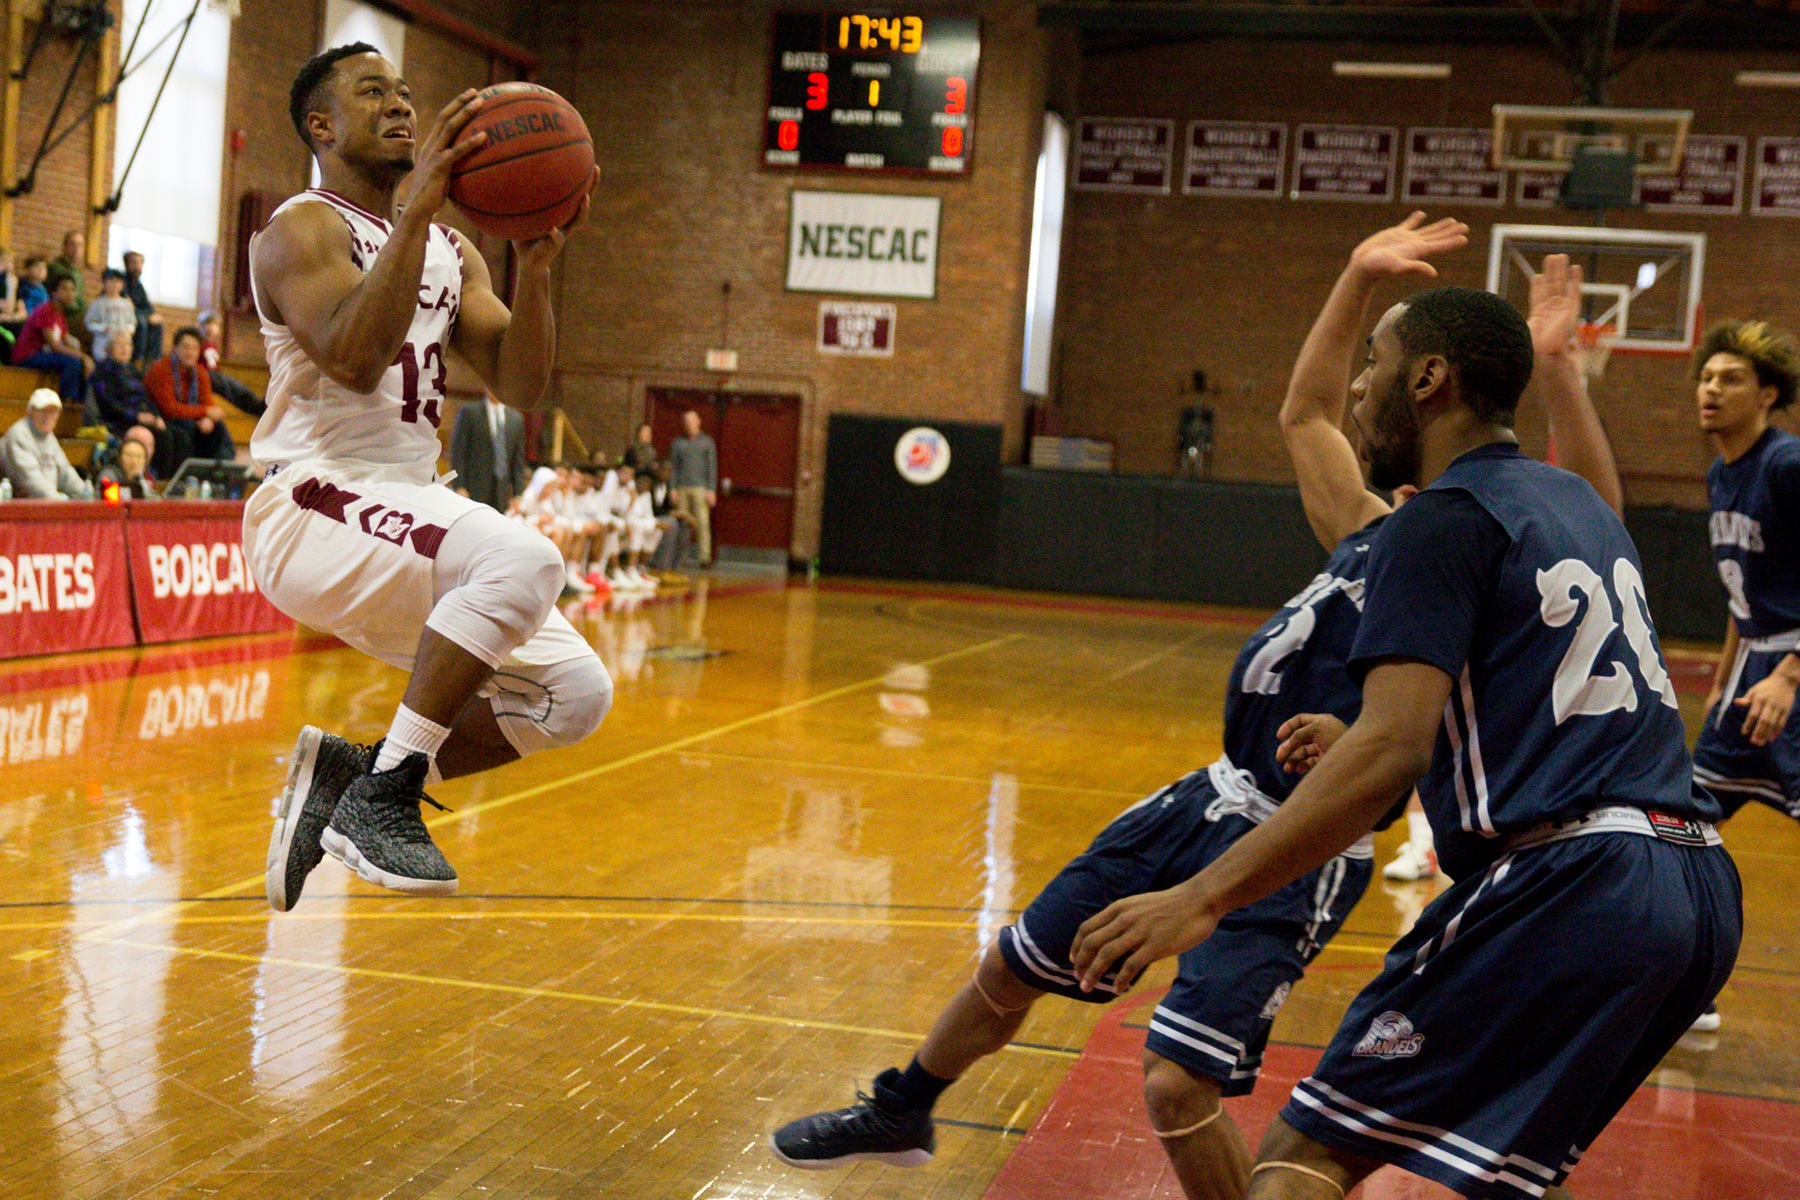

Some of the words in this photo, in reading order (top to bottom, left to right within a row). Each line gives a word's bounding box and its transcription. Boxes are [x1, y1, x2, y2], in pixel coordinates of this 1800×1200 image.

[838, 14, 923, 53] 17:43
[805, 72, 829, 111] 3
[868, 79, 880, 107] 1
[943, 76, 967, 115] 3
[486, 112, 566, 147] NESCAC
[778, 119, 799, 151] 0
[942, 126, 963, 157] 0
[799, 222, 930, 263] NESCAC
[390, 341, 447, 429] 13
[1535, 557, 1679, 726] 20
